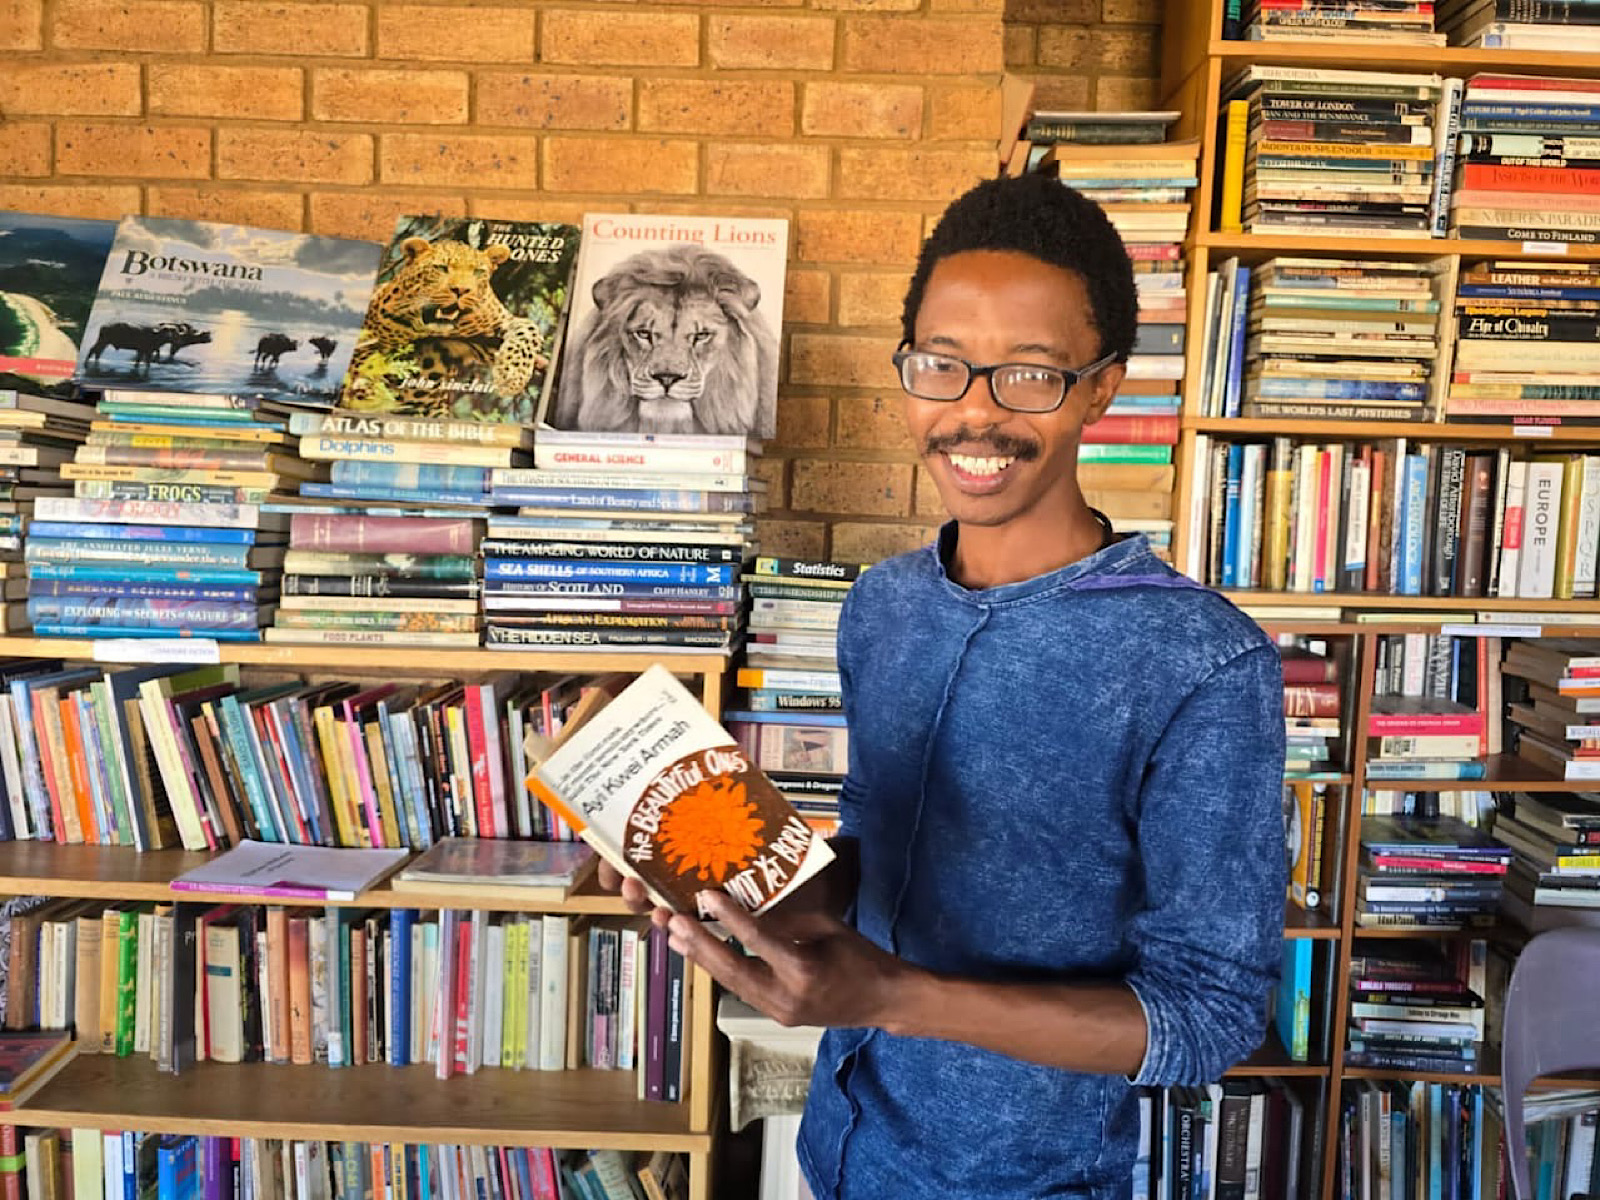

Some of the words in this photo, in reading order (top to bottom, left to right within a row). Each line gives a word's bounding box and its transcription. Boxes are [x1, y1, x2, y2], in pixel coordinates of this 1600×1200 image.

[593, 219, 704, 246] Counting
[713, 224, 776, 244] Lions
[1507, 229, 1536, 239] COME
[1538, 232, 1550, 240] TO
[1552, 231, 1595, 241] FINLAND
[487, 233, 565, 250] HUNTED
[510, 248, 563, 264] ONES
[120, 249, 264, 281] Botswana
[1491, 273, 1541, 285] LEATHER
[1260, 405, 1280, 414] THE
[1328, 407, 1354, 416] LAST
[1357, 409, 1412, 419] MYSTERIES
[322, 417, 381, 435] ATLAS
[384, 419, 407, 436] OF
[411, 420, 443, 438] THE
[448, 423, 498, 441] BIBLE
[319, 439, 395, 454] Dolphins
[554, 452, 601, 464] GENERAL
[606, 454, 646, 465] SCIENCE
[149, 485, 202, 500] FROGS
[1533, 479, 1551, 546] EUROPE
[1443, 486, 1459, 560] Attenborough
[516, 545, 584, 558] AMAZING
[587, 546, 635, 559] WORLD
[638, 547, 659, 559] OF
[659, 547, 710, 561] NATURE
[499, 563, 523, 576] SEA
[527, 564, 573, 577] SHELLS
[576, 568, 587, 576] OF
[589, 567, 636, 577] SOUTHERN
[637, 569, 669, 578] AFRICA
[793, 562, 845, 577] Statistics
[549, 582, 624, 595] SCOTLAND
[64, 605, 121, 618] EXPLORING
[133, 608, 178, 621] SECRETS
[187, 611, 227, 622] NATURE
[543, 613, 592, 625] AFRICAN
[323, 633, 347, 642] FOOD
[349, 633, 384, 643] PLANTS
[495, 631, 522, 643] THE
[521, 631, 573, 644] HIDDEN
[574, 632, 600, 645] SEA
[778, 694, 823, 709] Windows
[827, 696, 842, 709] 95
[582, 788, 608, 818] Ayi
[602, 757, 643, 796] Kwei
[640, 720, 691, 765] Armah
[768, 815, 812, 867] BORN
